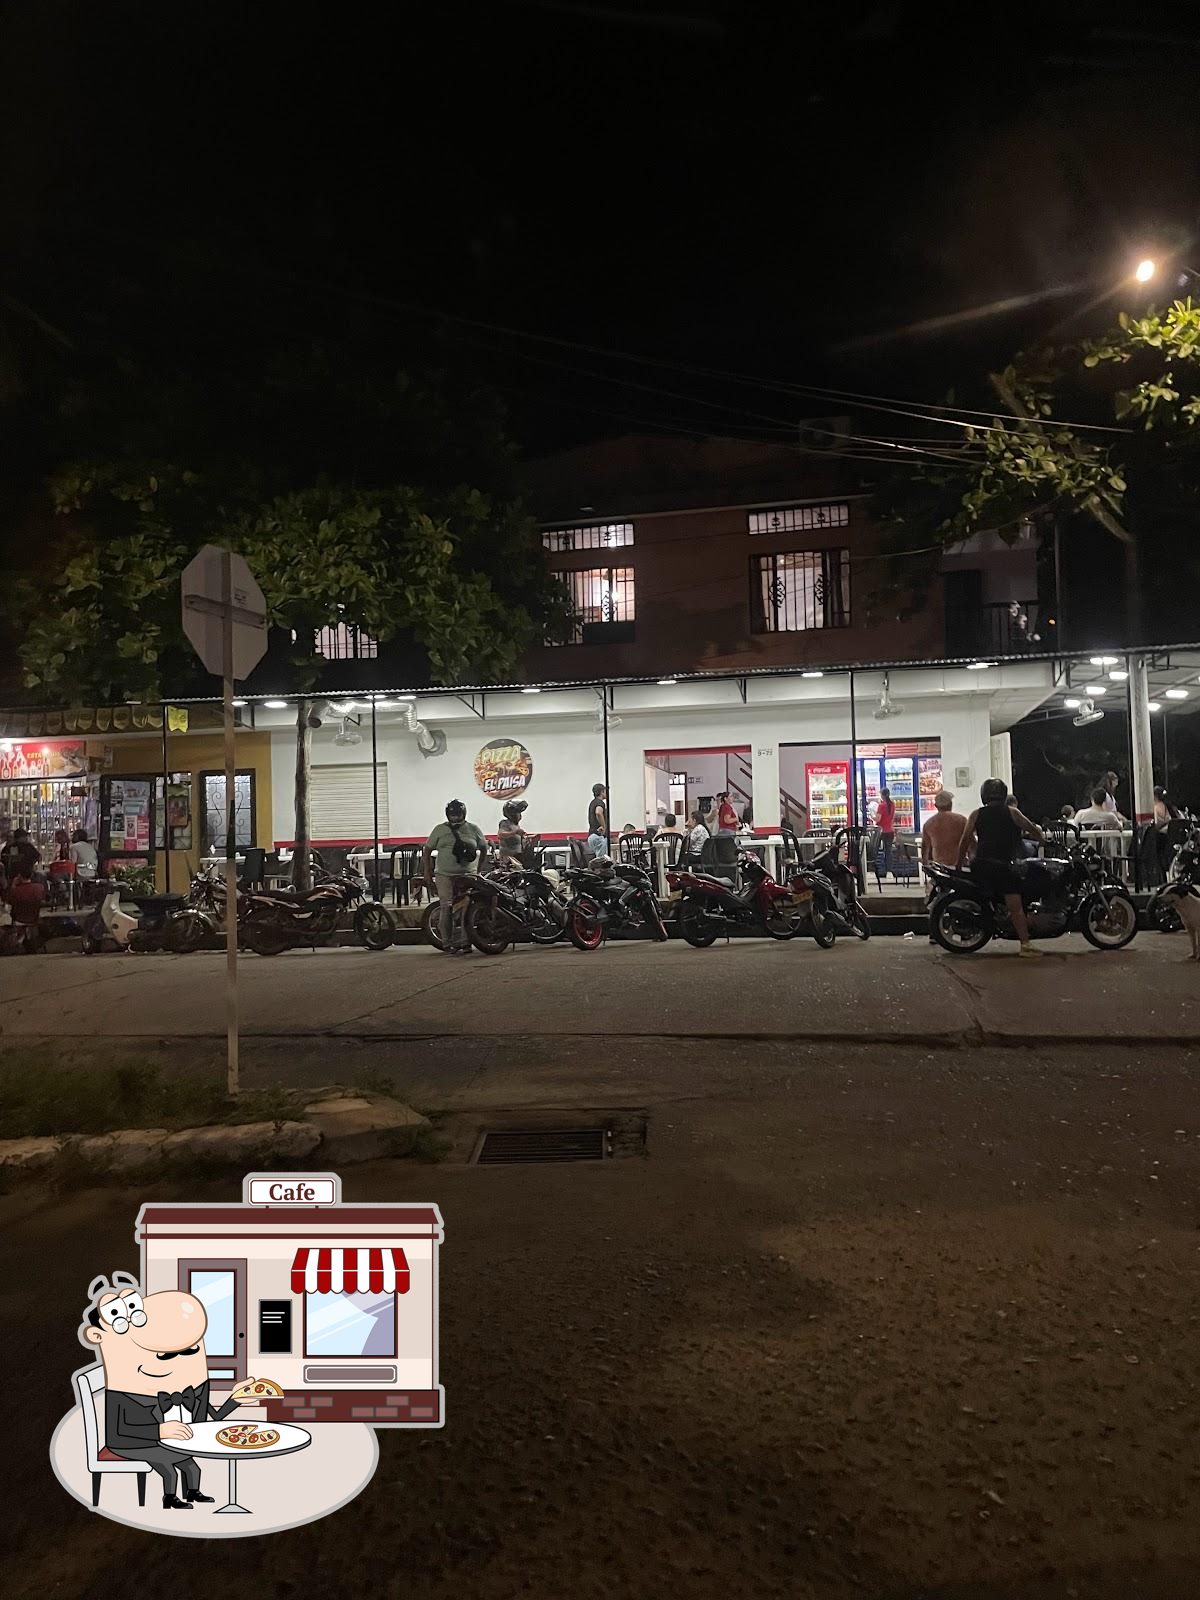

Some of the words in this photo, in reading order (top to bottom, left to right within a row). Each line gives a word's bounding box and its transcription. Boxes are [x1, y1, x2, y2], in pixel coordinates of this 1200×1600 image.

[481, 745, 521, 764] PIZZA
[484, 778, 496, 792] EL
[497, 775, 526, 790] PAISA
